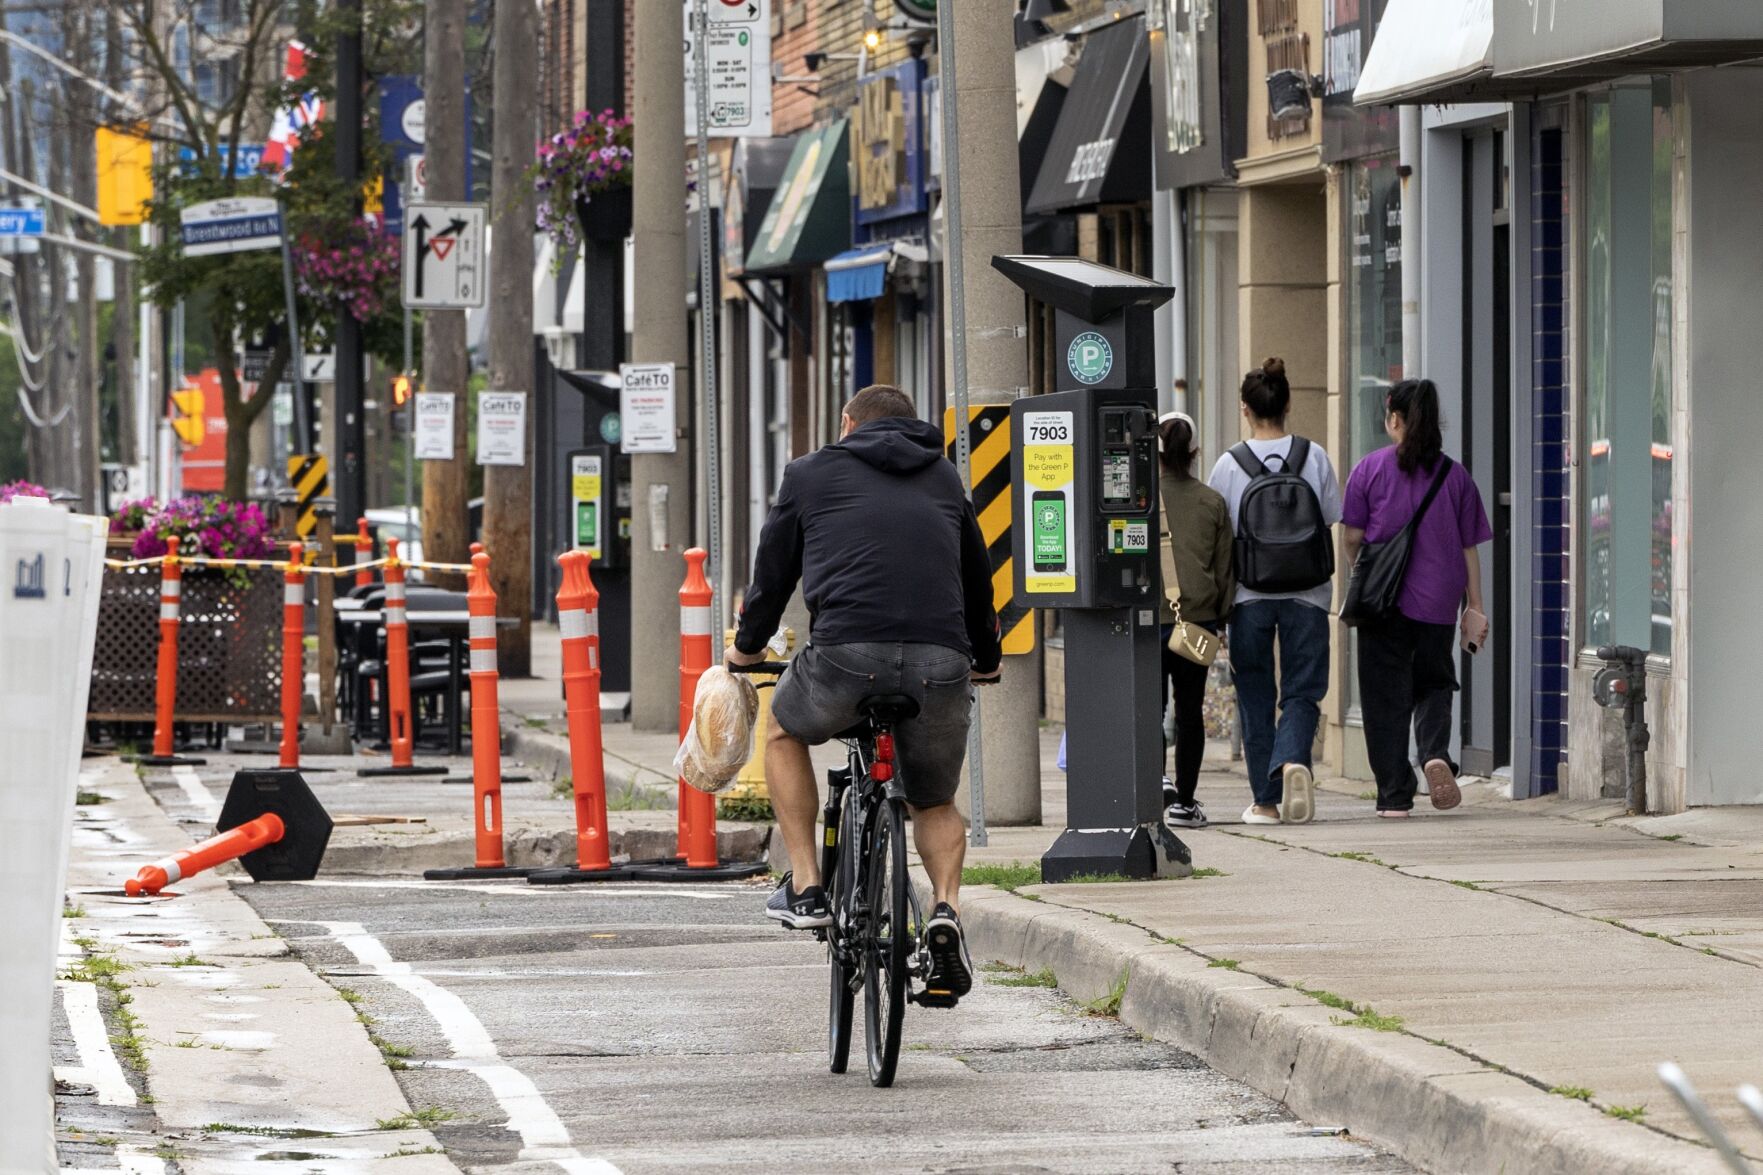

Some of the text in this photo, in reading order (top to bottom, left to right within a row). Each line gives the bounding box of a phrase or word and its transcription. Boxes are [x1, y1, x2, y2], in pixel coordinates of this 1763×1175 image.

[727, 107, 745, 116] 7903
[184, 221, 252, 243] Brentwood
[268, 216, 280, 234] N
[1082, 346, 1099, 366] P
[1030, 426, 1068, 441] 7903
[1034, 453, 1062, 462] Pay with
[577, 464, 598, 473] 7903
[1041, 463, 1062, 471] Green
[1041, 473, 1056, 481] App
[1045, 511, 1054, 523] P
[1127, 534, 1146, 546] 7903
[1037, 545, 1062, 553] TODAY!
